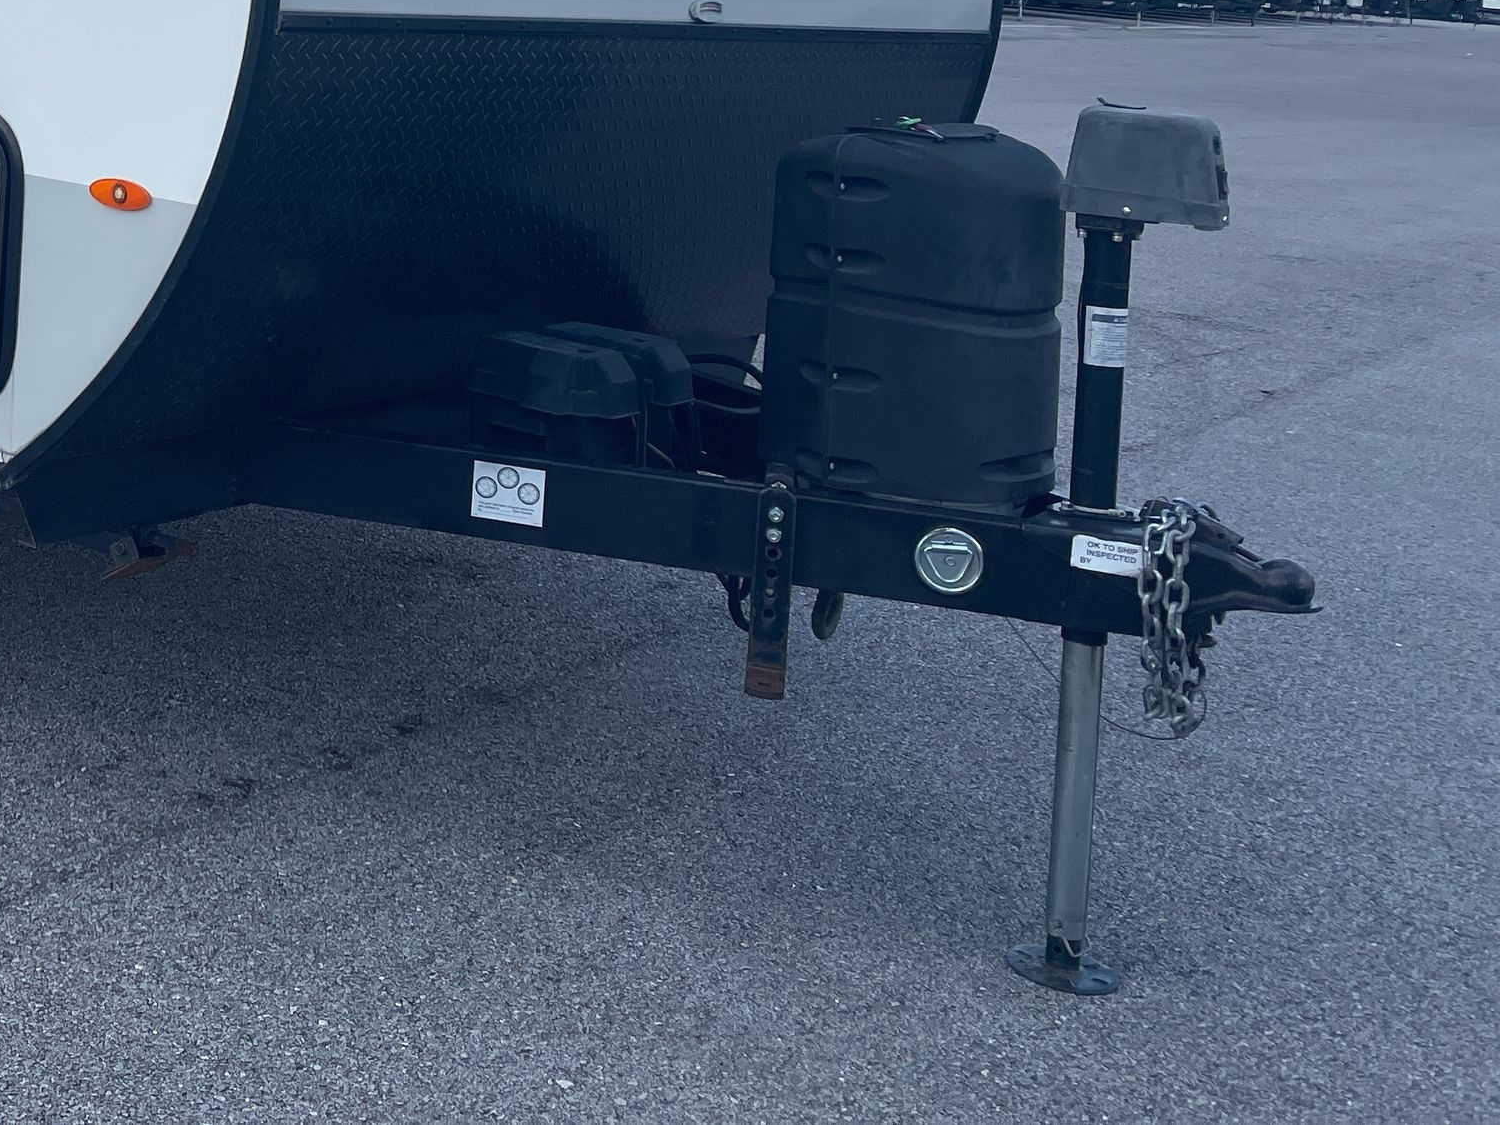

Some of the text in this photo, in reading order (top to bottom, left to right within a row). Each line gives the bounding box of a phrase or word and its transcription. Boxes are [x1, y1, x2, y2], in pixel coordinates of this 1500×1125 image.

[1087, 541, 1138, 555] OK TO SHIP
[1086, 550, 1136, 563] INSPECTED
